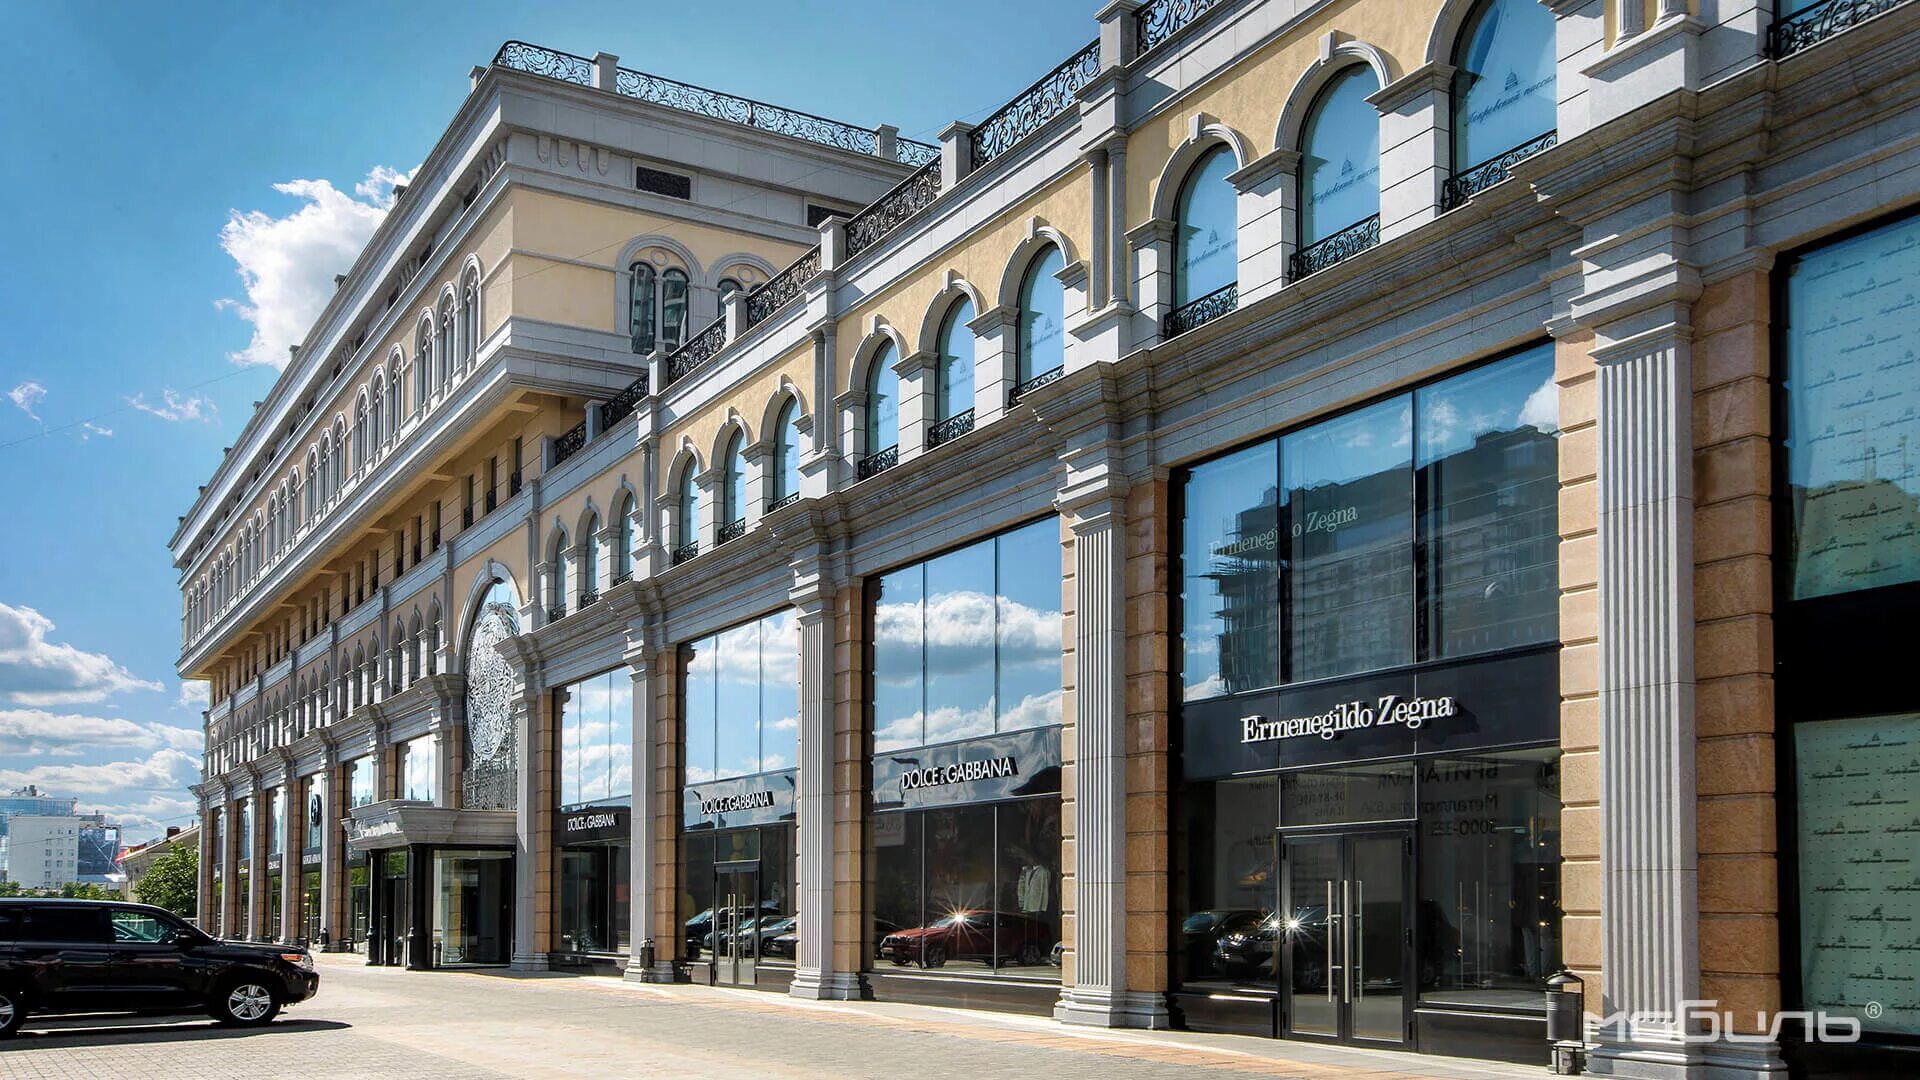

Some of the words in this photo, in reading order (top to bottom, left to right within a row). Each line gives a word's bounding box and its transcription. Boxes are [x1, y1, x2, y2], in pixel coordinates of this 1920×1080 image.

[1304, 506, 1358, 533] Zegna
[1240, 702, 1373, 743] Ermenegildo
[1377, 695, 1454, 728] Zegna
